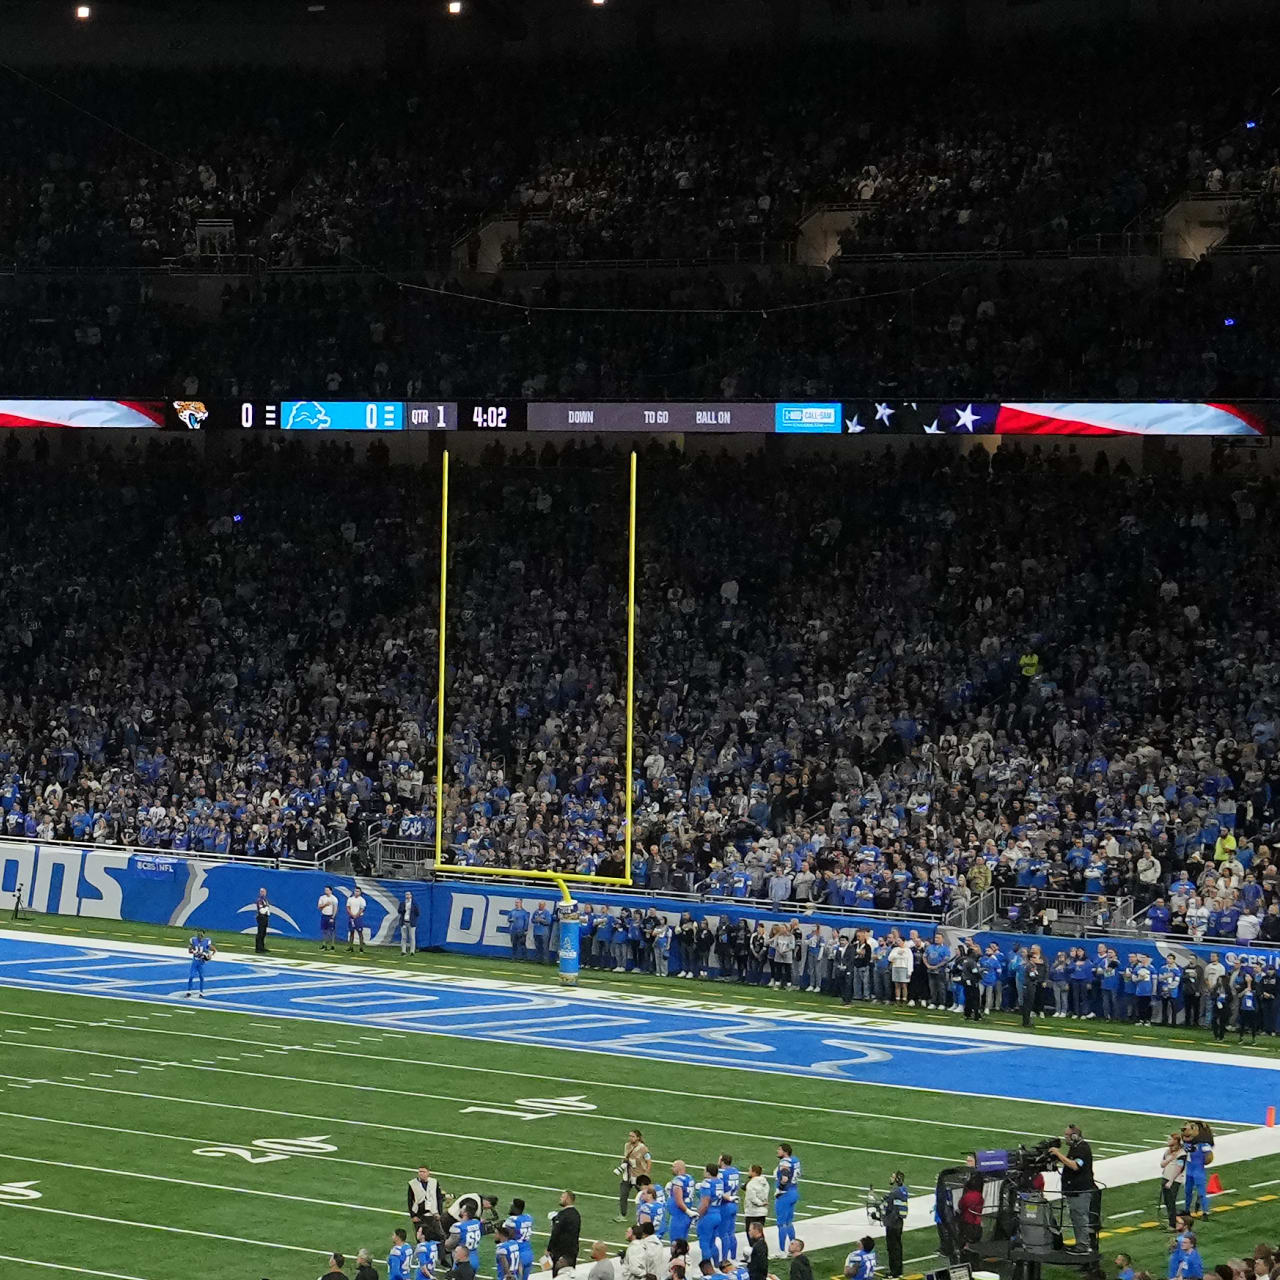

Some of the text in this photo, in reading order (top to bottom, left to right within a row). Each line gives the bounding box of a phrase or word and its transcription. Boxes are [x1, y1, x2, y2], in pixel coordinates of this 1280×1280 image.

[241, 402, 253, 428] 0
[365, 403, 378, 429] 0
[411, 406, 447, 428] QTR 1
[472, 406, 508, 428] 4:02
[568, 410, 594, 424] DOWN
[644, 411, 669, 424] TO GO
[696, 411, 731, 424] BALL ON
